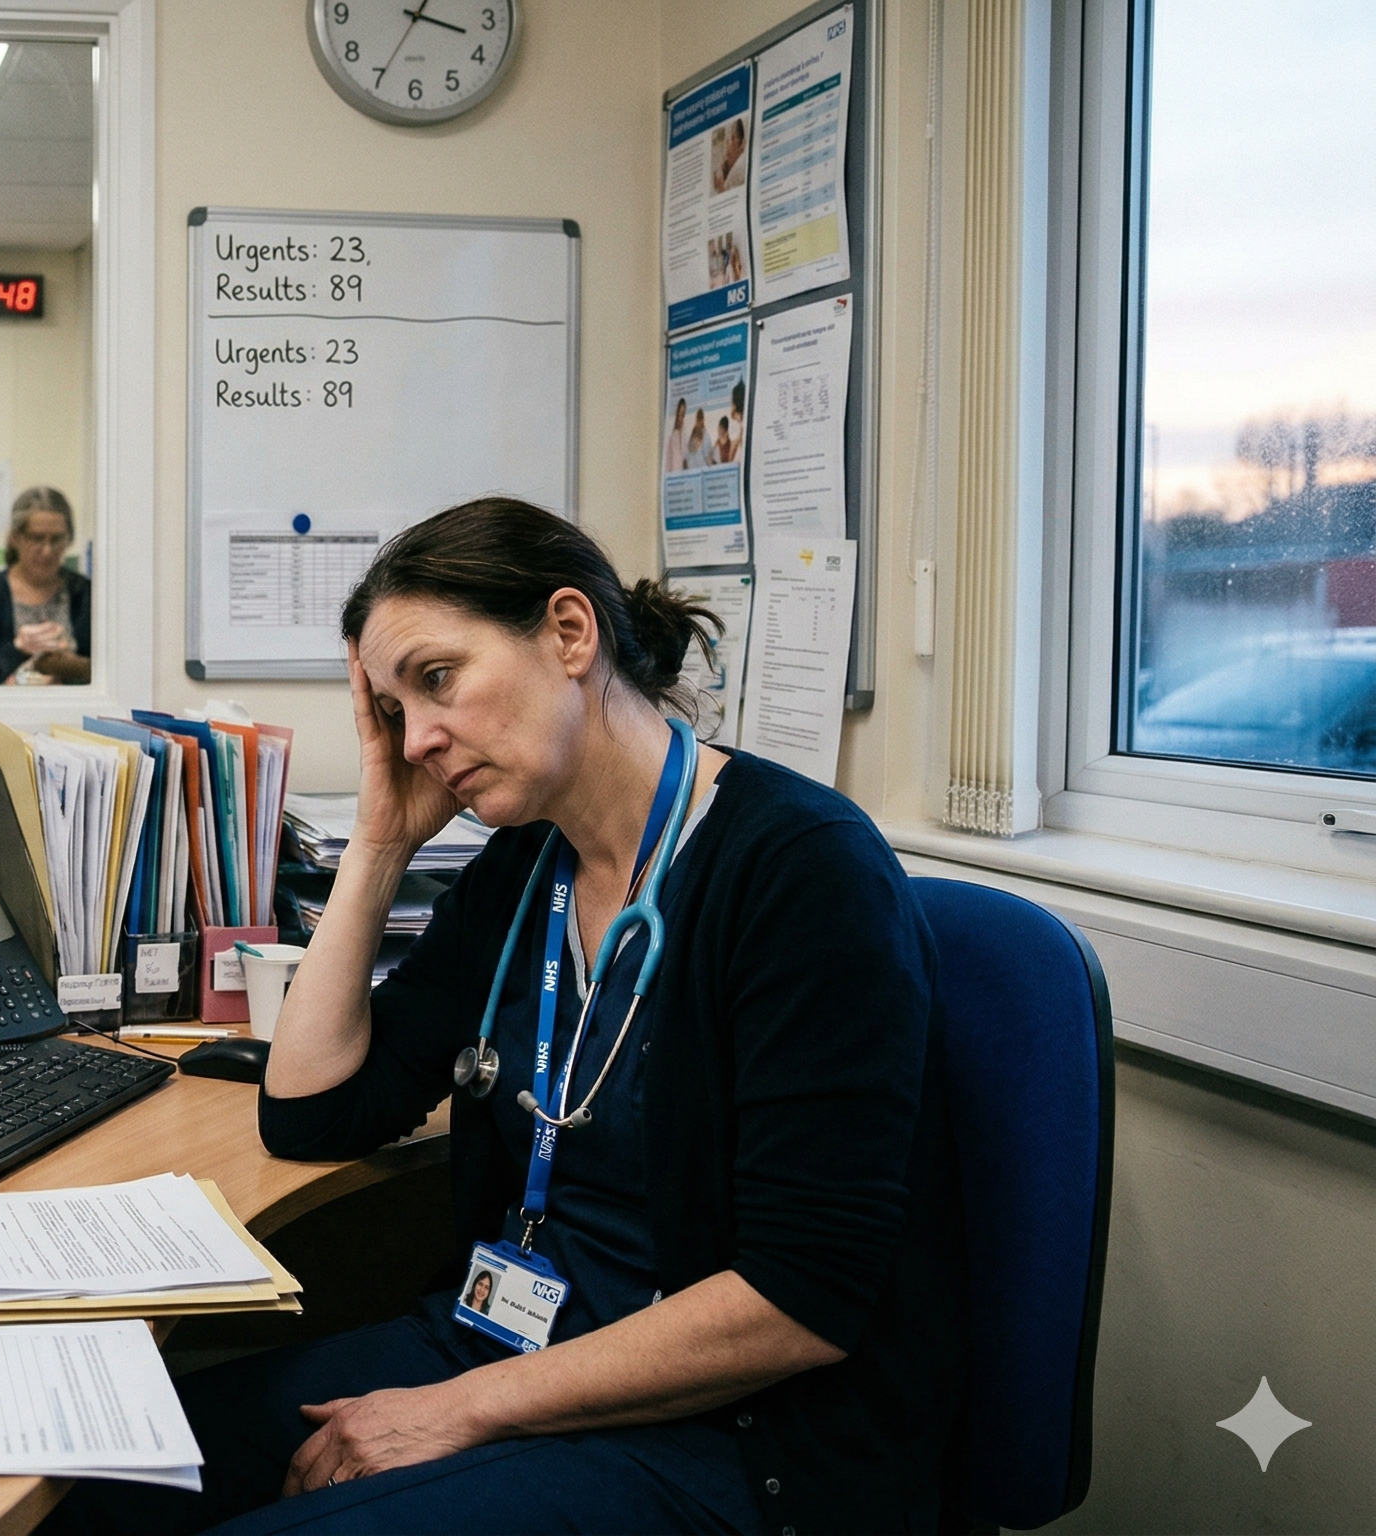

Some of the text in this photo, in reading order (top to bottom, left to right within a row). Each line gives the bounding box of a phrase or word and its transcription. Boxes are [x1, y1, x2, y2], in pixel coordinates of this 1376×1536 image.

[334, 3, 349, 25] 9
[481, 9, 496, 31] 3
[344, 40, 360, 62] 8
[470, 44, 486, 66] 4
[372, 67, 386, 90] 7
[408, 79, 423, 101] 6
[445, 69, 460, 92] 5
[216, 234, 318, 271] Urgents:
[216, 275, 364, 303] Results: 89
[216, 338, 360, 374] Urgents: 23
[216, 380, 355, 409] Results: 89
[552, 883, 568, 913] NHS
[544, 960, 558, 992] NHS
[533, 1282, 561, 1303] NHS
